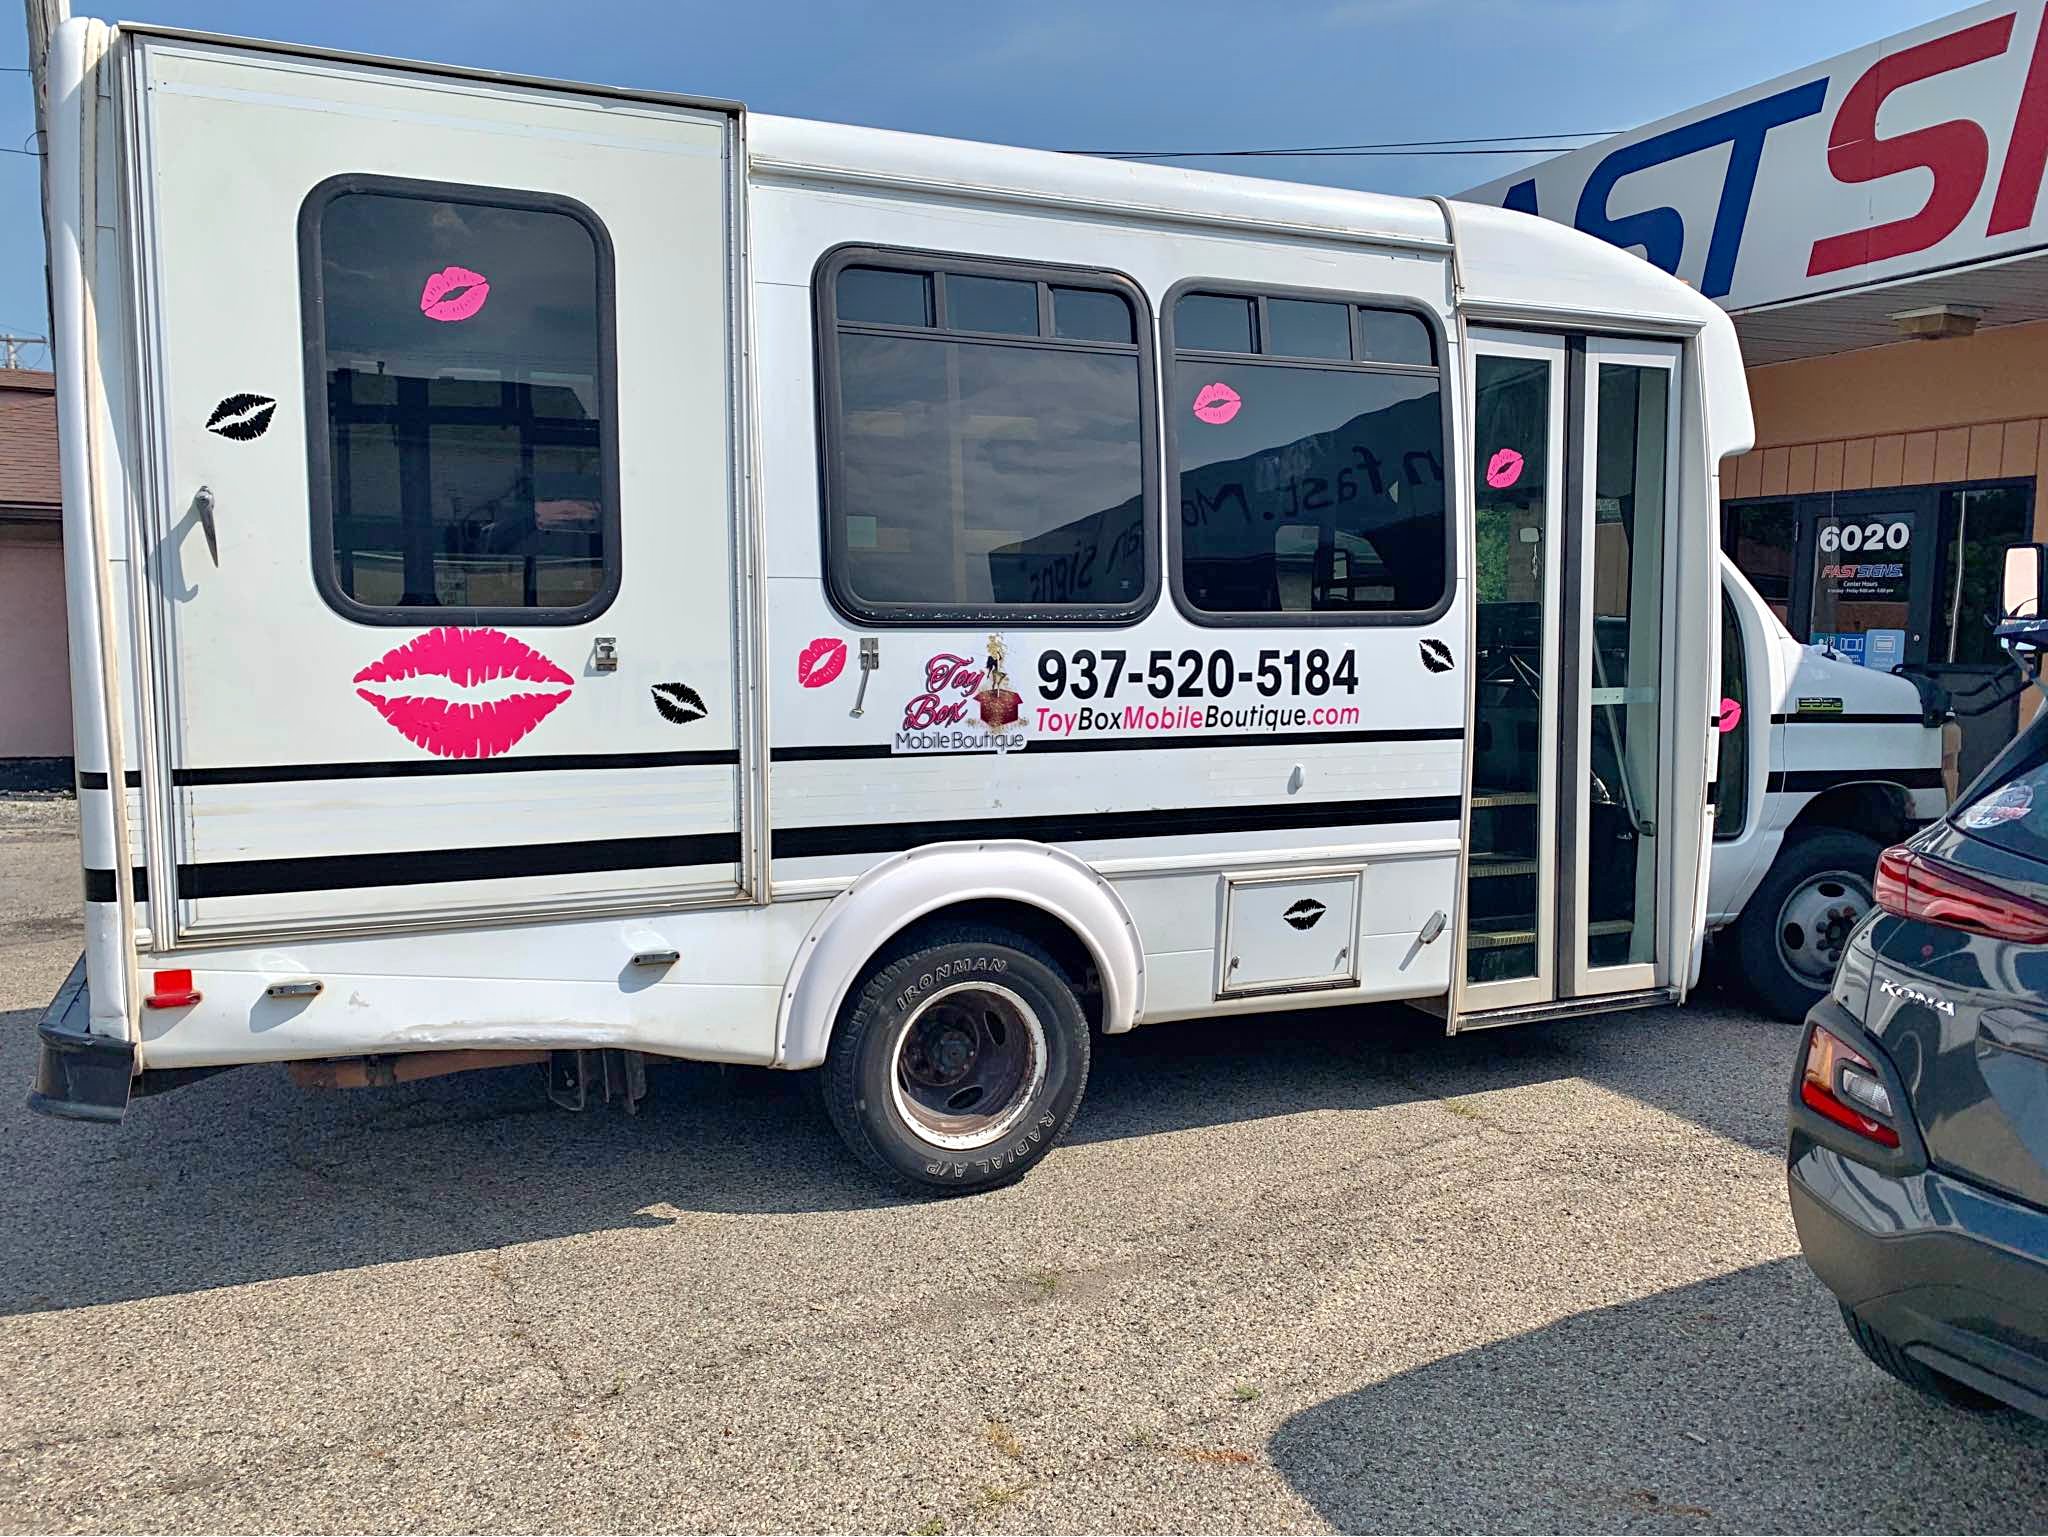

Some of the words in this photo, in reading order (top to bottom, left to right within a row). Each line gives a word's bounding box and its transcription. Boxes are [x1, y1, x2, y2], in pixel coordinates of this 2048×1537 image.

[1820, 522, 1910, 552] 6020
[925, 653, 986, 697] Toy
[1037, 649, 1360, 700] 937-520-5184
[903, 693, 968, 731] Box
[1036, 704, 1361, 736] ToyBoxMobileBoutique.com
[896, 957, 1008, 1011] IRONMAN
[1880, 979, 1955, 1017] KONA
[976, 1111, 1056, 1175] RADIAL
